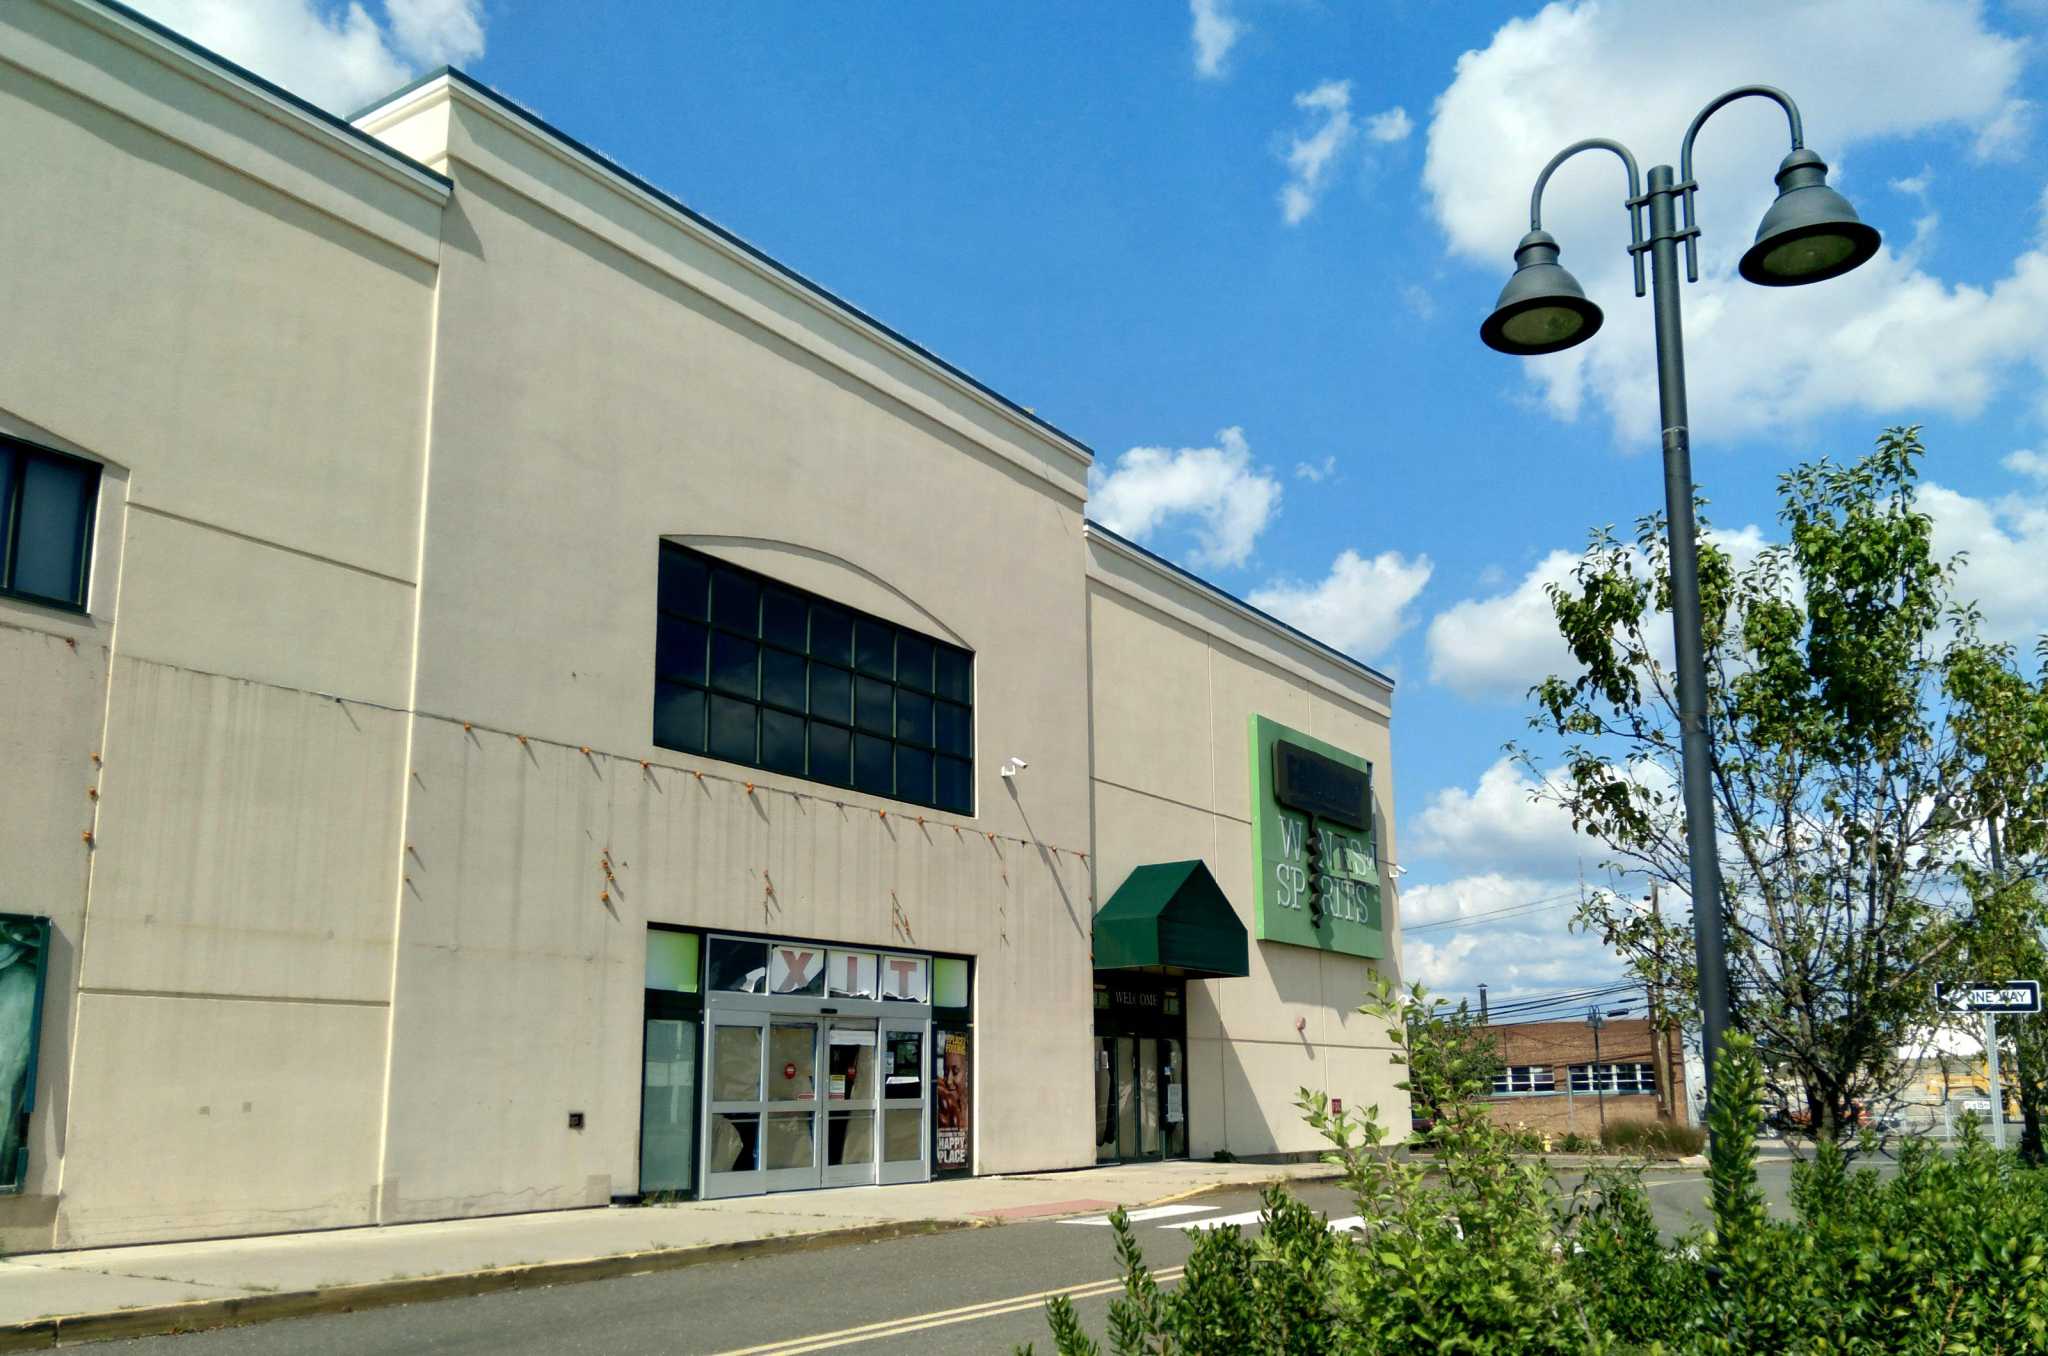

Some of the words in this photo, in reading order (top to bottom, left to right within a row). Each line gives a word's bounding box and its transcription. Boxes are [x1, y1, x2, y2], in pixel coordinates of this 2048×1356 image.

[1278, 815, 1367, 876] WNS
[1276, 863, 1369, 924] SPRITS
[1115, 991, 1159, 1007] WELCOME
[1999, 991, 2026, 1003] WAY
[938, 1149, 966, 1163] PLACE
